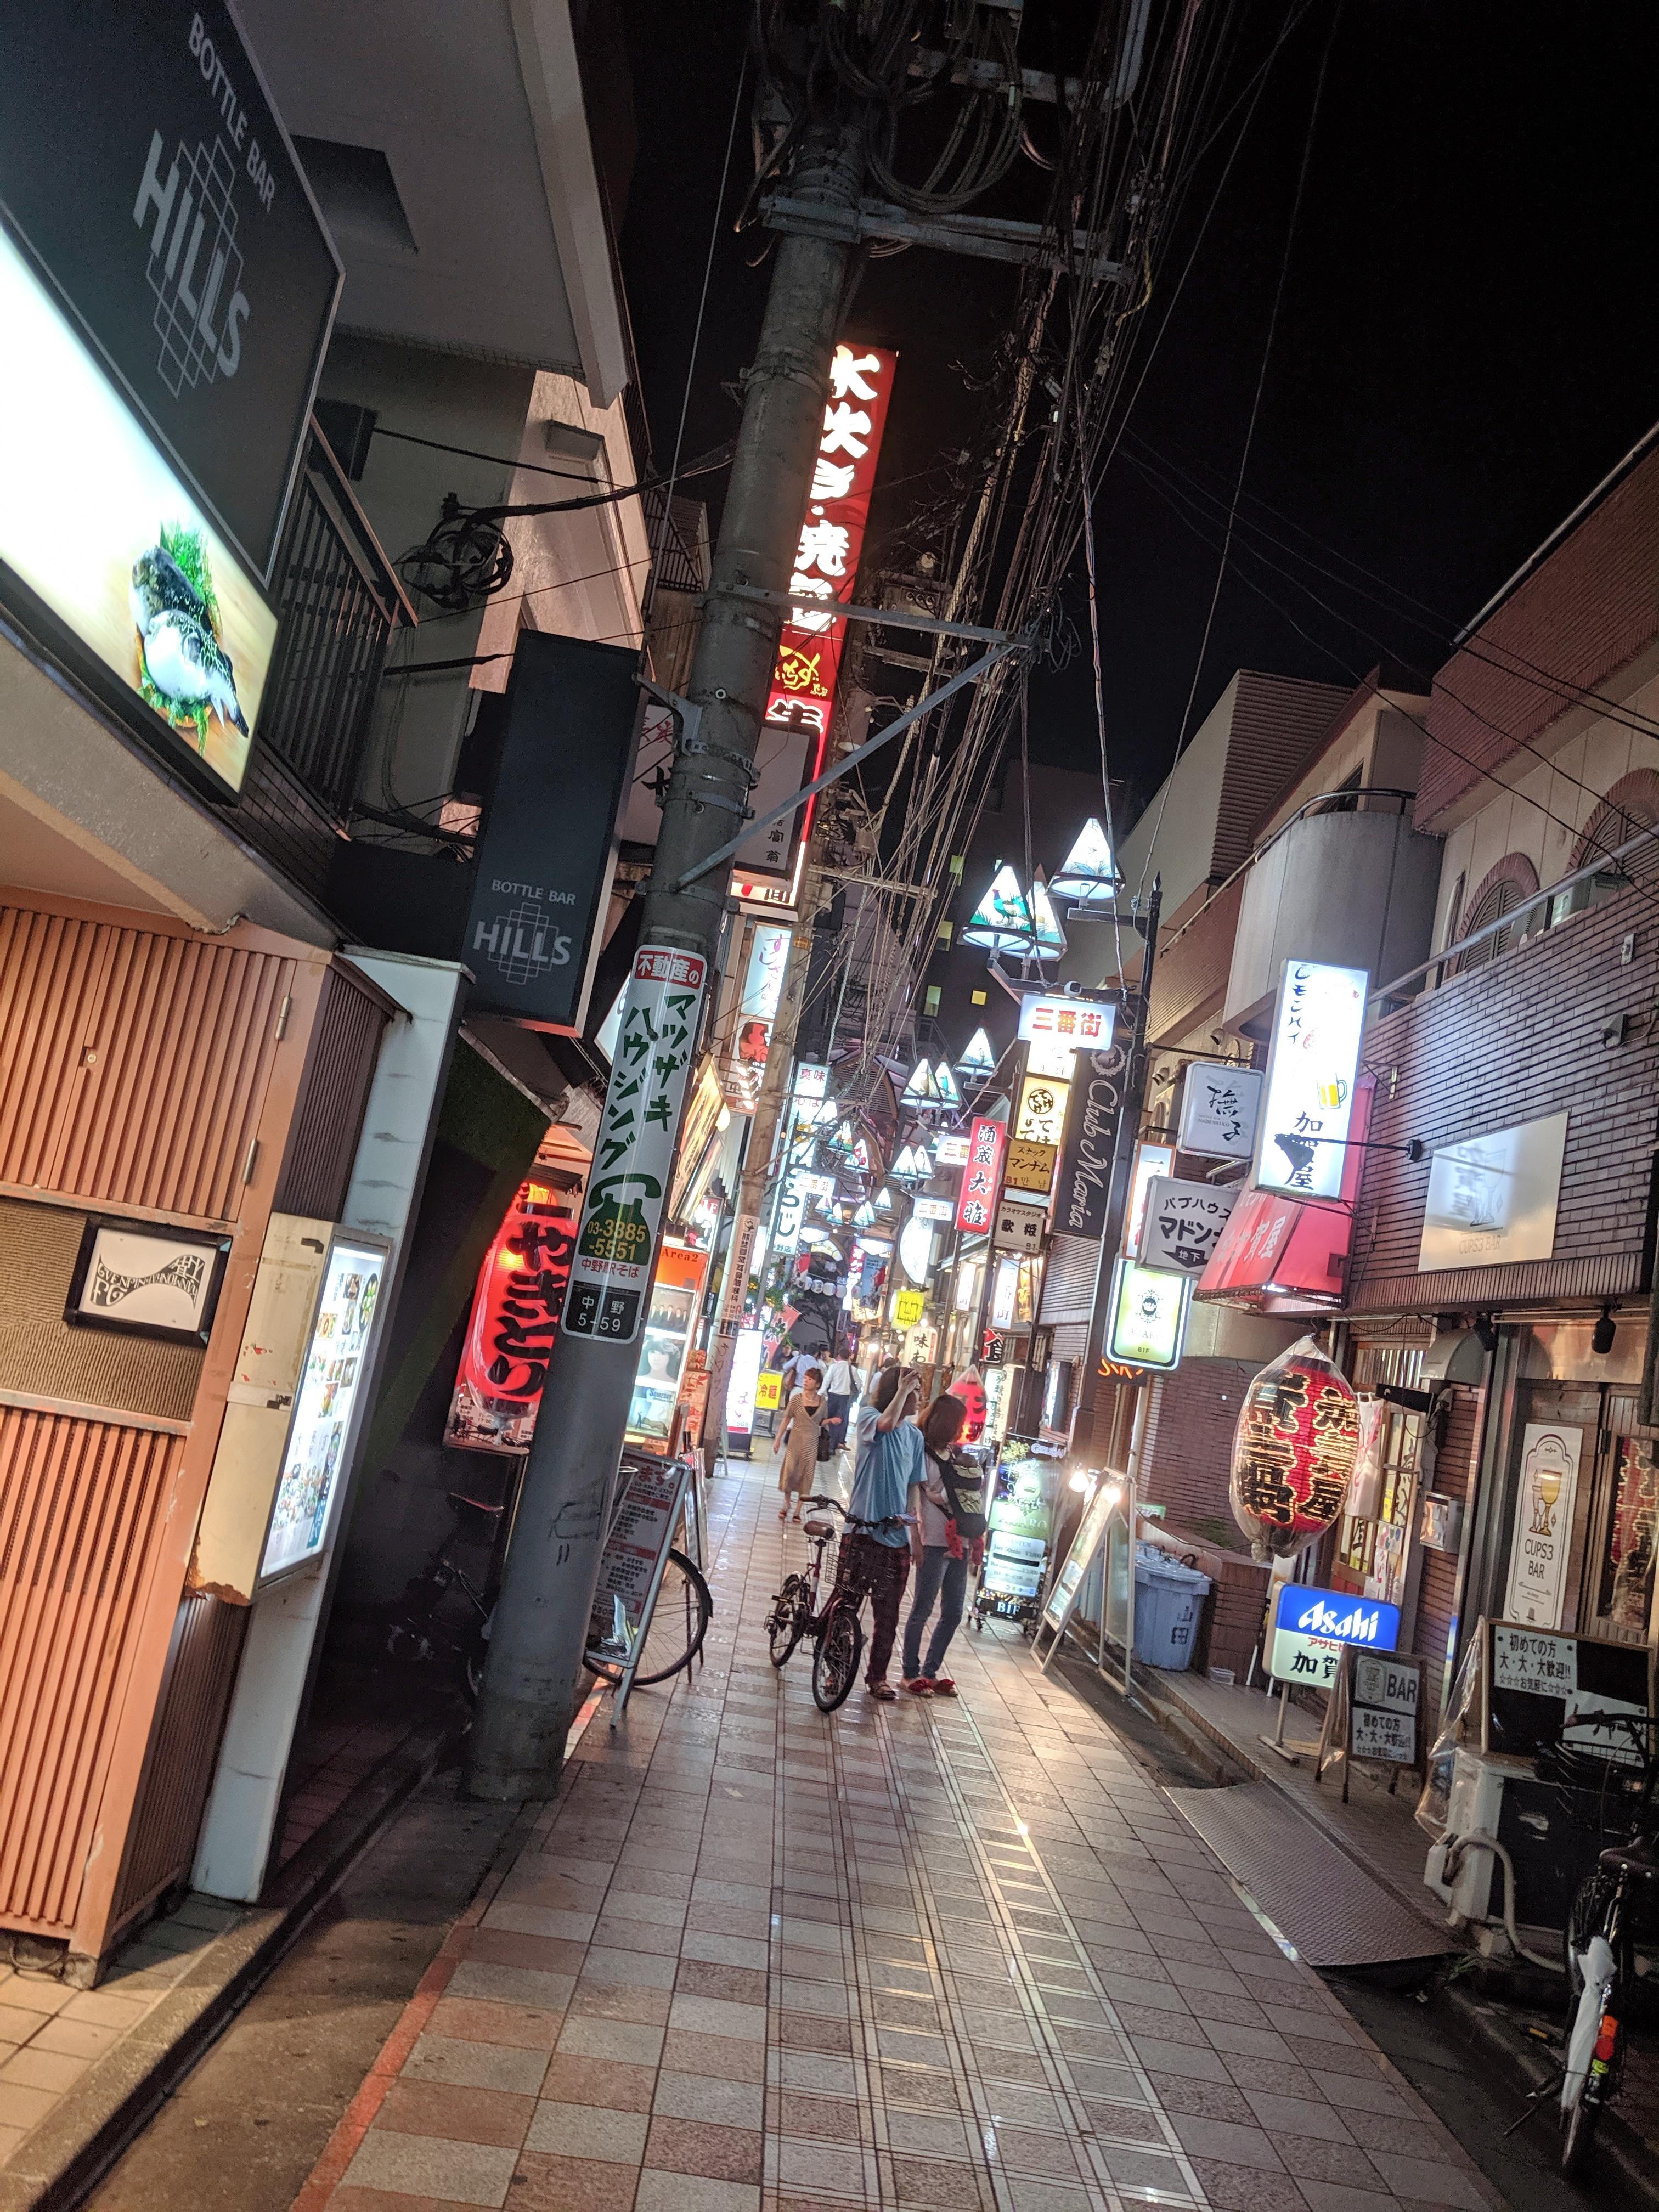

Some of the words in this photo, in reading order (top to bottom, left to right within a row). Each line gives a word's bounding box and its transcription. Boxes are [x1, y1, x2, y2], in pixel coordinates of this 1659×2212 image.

[189, 13, 247, 151] BOTTLE
[246, 139, 276, 213] BAR
[133, 129, 249, 376] HILLS
[492, 879, 544, 900] BOTTLE
[548, 890, 575, 906] BAR
[473, 921, 573, 965] HILLS
[637, 953, 699, 986] 不動産の
[1032, 1007, 1102, 1037] 三番街
[644, 993, 697, 1132] マツザキ
[799, 1068, 826, 1082] 真味
[600, 1006, 652, 1171] ハウジング
[1082, 1079, 1118, 1137] Club
[1018, 1147, 1046, 1156] スナック
[963, 1124, 997, 1226] 酒蔵大雅
[1009, 1158, 1049, 1173] マンナム
[1005, 1176, 1018, 1184] B1
[1069, 1141, 1109, 1228] Maria
[1001, 1206, 1041, 1218] カラオケスタジオ
[1164, 1197, 1231, 1221] パブハウス
[662, 1248, 699, 1262] Area2
[1178, 1250, 1201, 1262] 地下
[1458, 1238, 1483, 1255] CUPS3
[1486, 1235, 1501, 1250] BAR
[582, 1258, 640, 1278] 中野駅そば
[582, 1295, 624, 1314] 中野
[578, 1313, 621, 1332] 5-59
[1525, 1539, 1554, 1560] CUPS3
[1528, 1561, 1545, 1579] BAR
[997, 1601, 1020, 1615] B1F
[1298, 1600, 1379, 1641] Asahi
[1510, 1634, 1556, 1657] 初めての方
[1386, 1674, 1417, 1703] BAR
[1363, 1713, 1400, 1731] 初めての方
